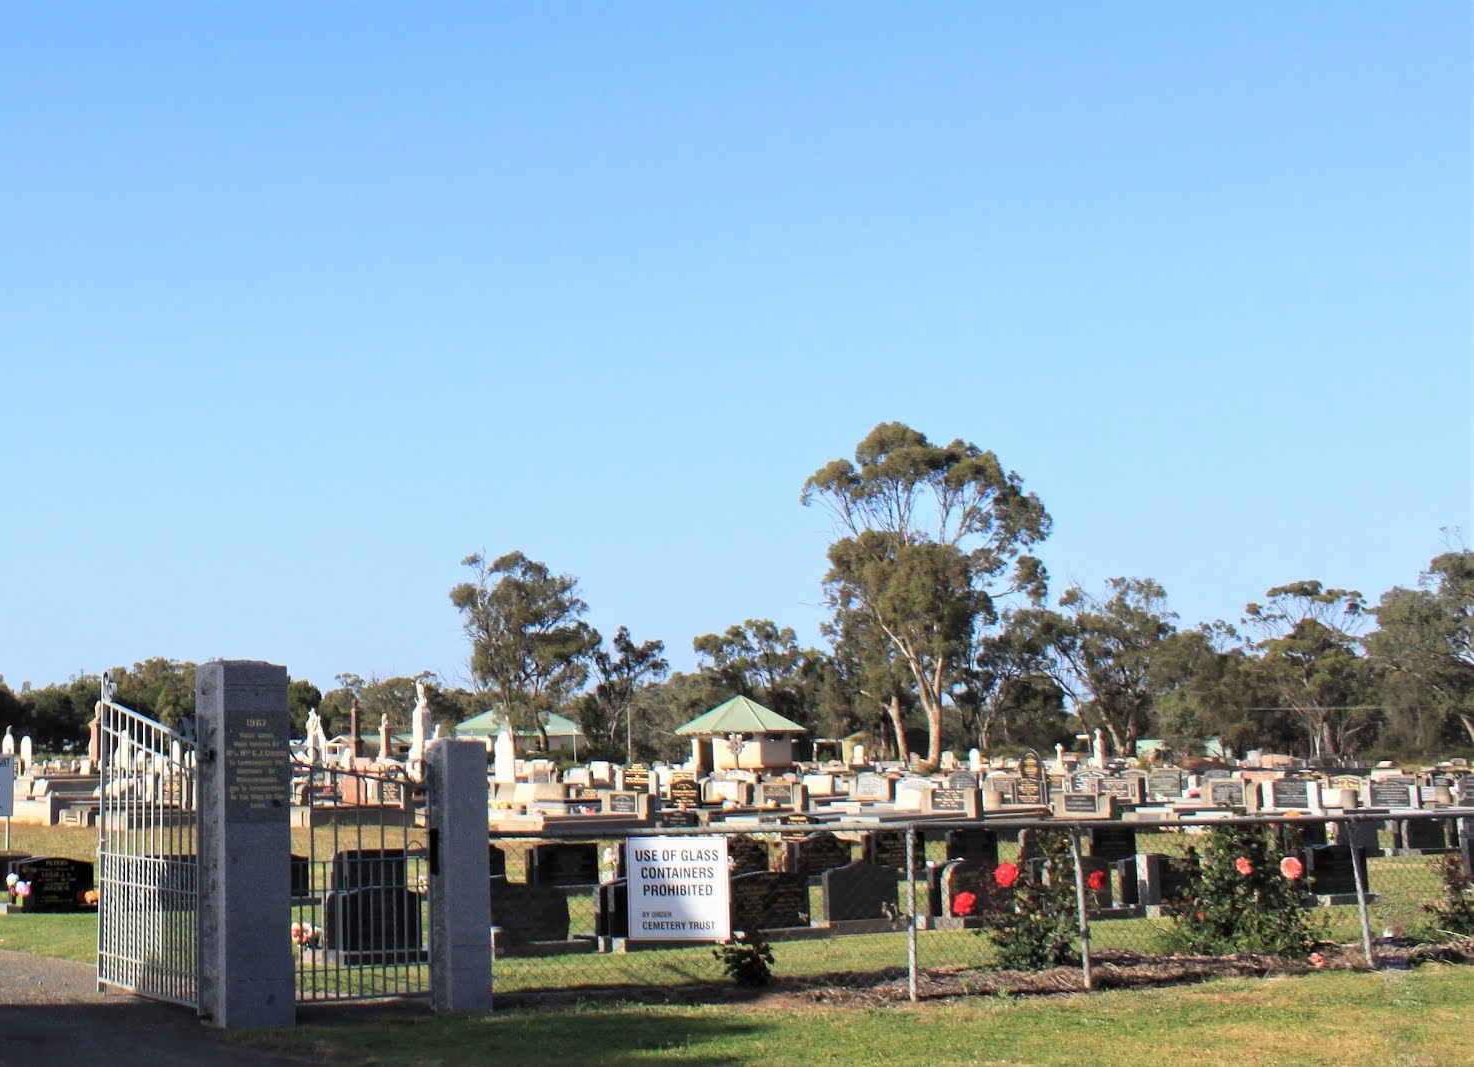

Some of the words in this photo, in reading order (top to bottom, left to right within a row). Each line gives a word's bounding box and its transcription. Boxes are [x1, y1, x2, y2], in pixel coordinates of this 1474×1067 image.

[635, 849, 658, 862] USE
[662, 849, 677, 862] OF
[681, 849, 719, 862] GLASS
[641, 867, 714, 879] CONTAINERS
[643, 884, 713, 896] PROHIBITED
[642, 921, 686, 930] CEMETERY
[689, 921, 715, 930] TRUST
